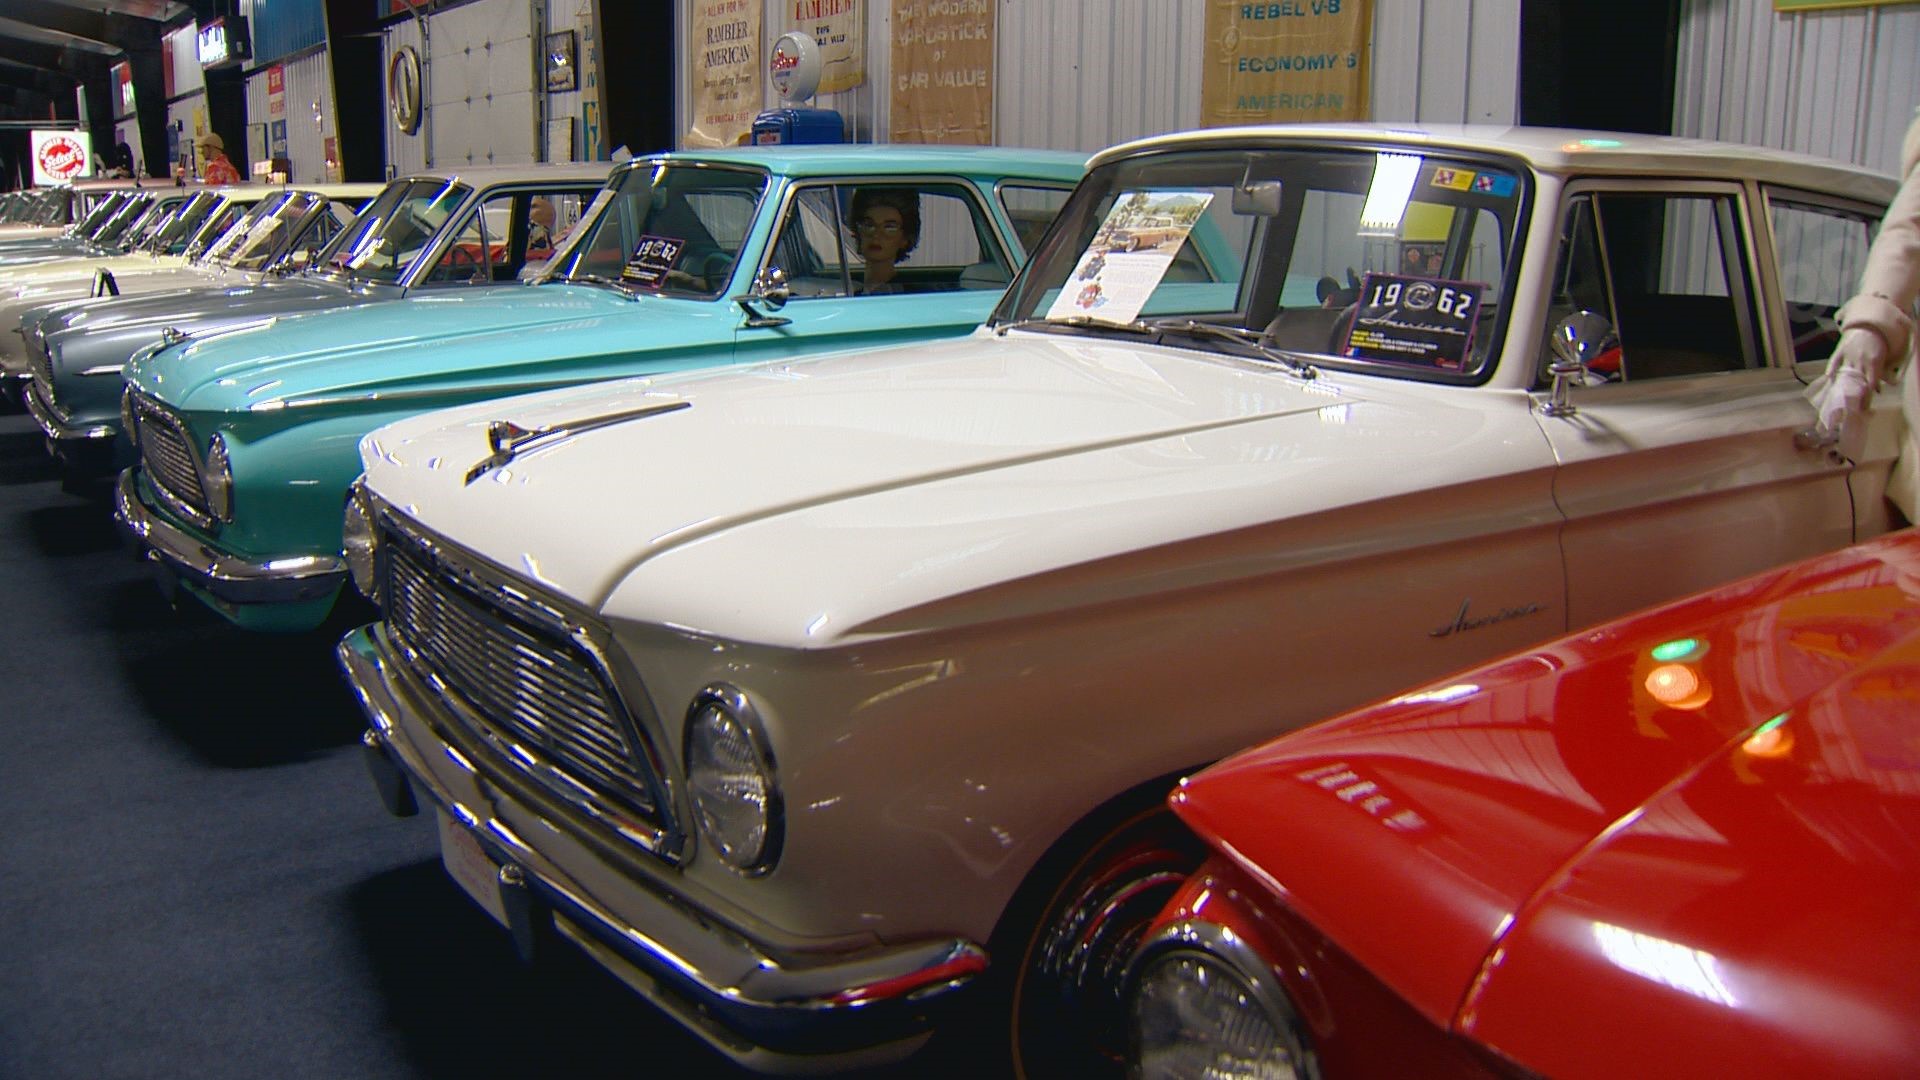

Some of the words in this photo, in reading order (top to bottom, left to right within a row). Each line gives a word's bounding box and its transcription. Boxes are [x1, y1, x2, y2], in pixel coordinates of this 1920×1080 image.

[1241, 2, 1305, 20] REBEL
[707, 20, 748, 45] RAMBLER
[704, 44, 750, 68] AMERICAN
[1238, 54, 1338, 72] ECONOMY
[898, 71, 928, 91] CAR
[934, 69, 986, 88] VALUE
[1237, 92, 1344, 111] AMERICAN
[1369, 283, 1402, 308] 19
[1436, 287, 1474, 319] 62
